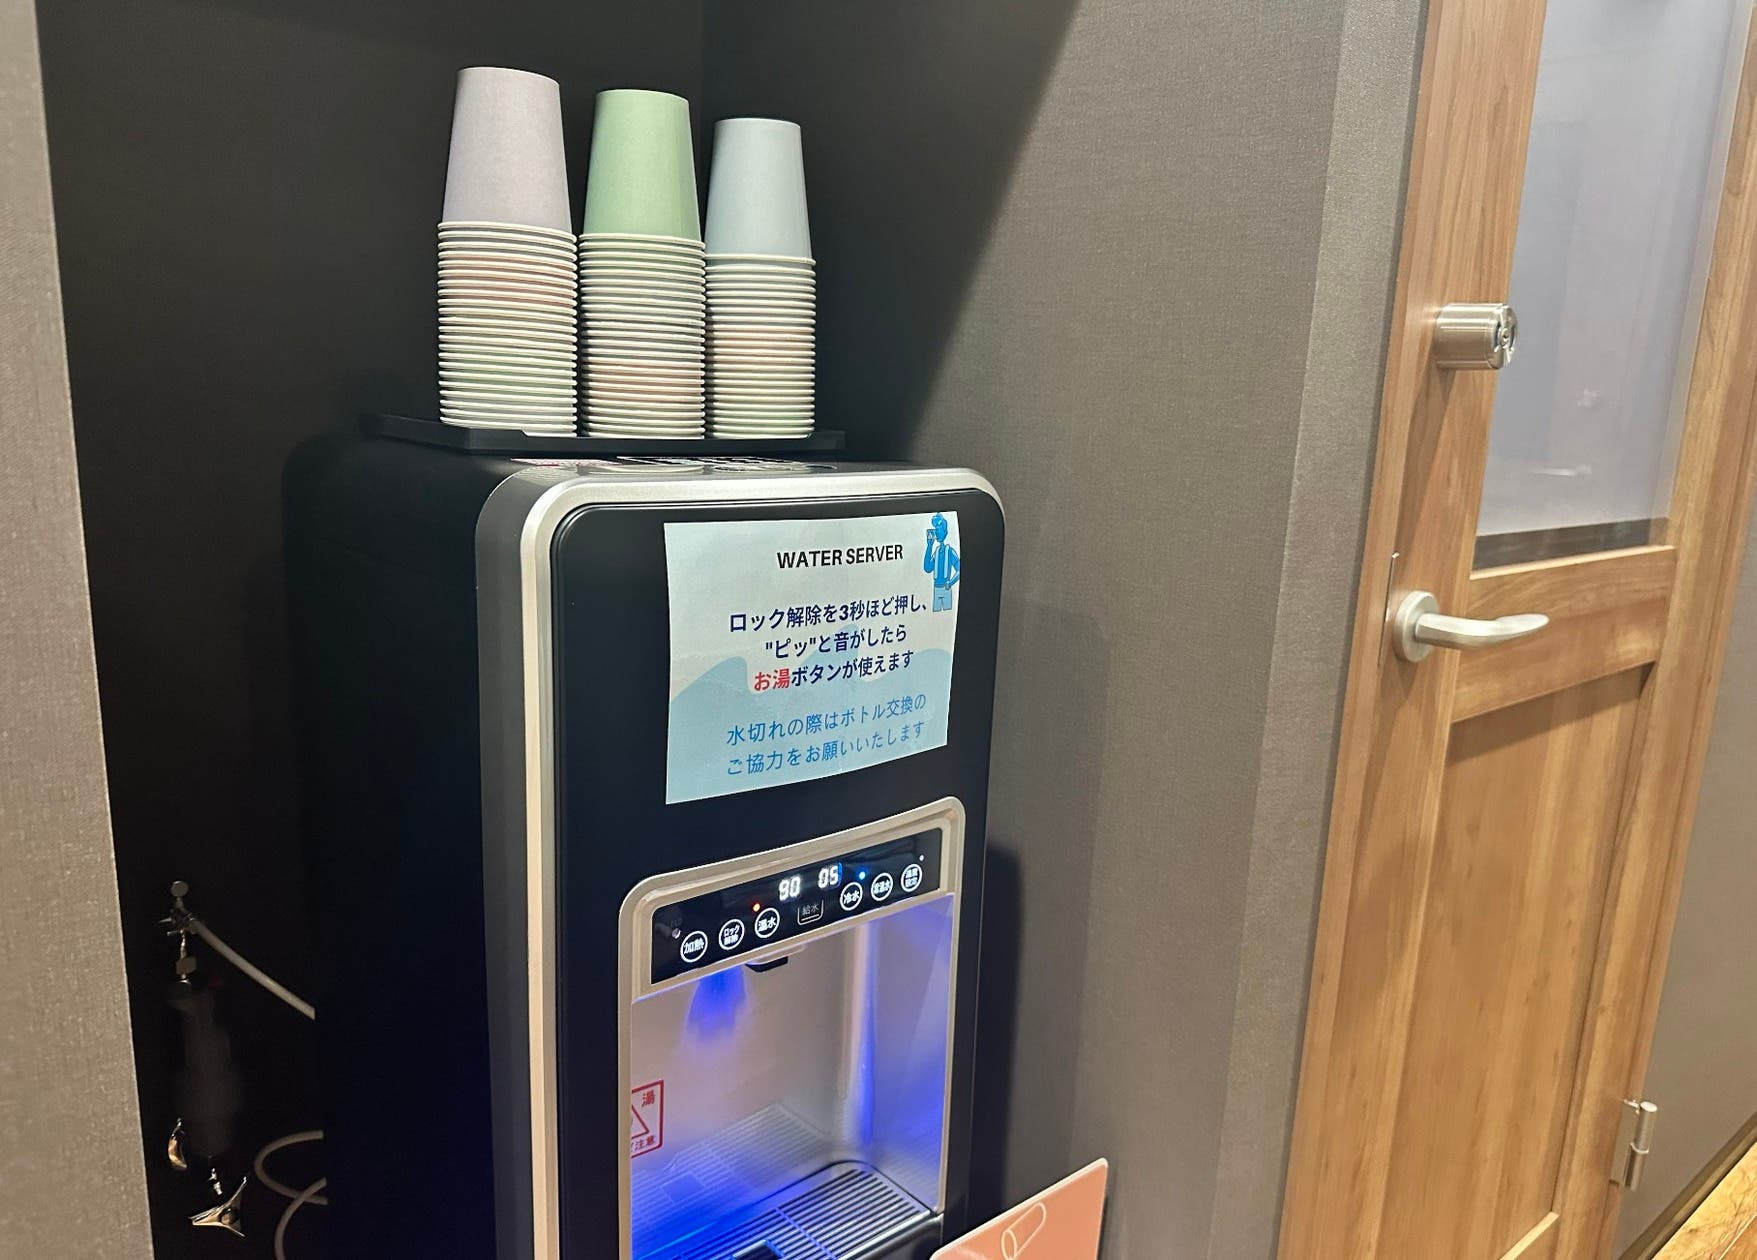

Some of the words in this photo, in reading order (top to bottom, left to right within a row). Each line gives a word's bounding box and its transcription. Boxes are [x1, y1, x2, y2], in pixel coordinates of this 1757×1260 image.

[777, 550, 842, 569] WATER
[846, 544, 904, 565] SERVER
[729, 594, 927, 632] ロック解除を3秒ほど押し、
[753, 650, 914, 691] お湯ボタンが使えます
[726, 694, 926, 746] 水切れの際はボトル交換の
[727, 721, 925, 776] ご協力をお願いいたします
[779, 876, 801, 901] 90
[801, 903, 819, 916] 給水
